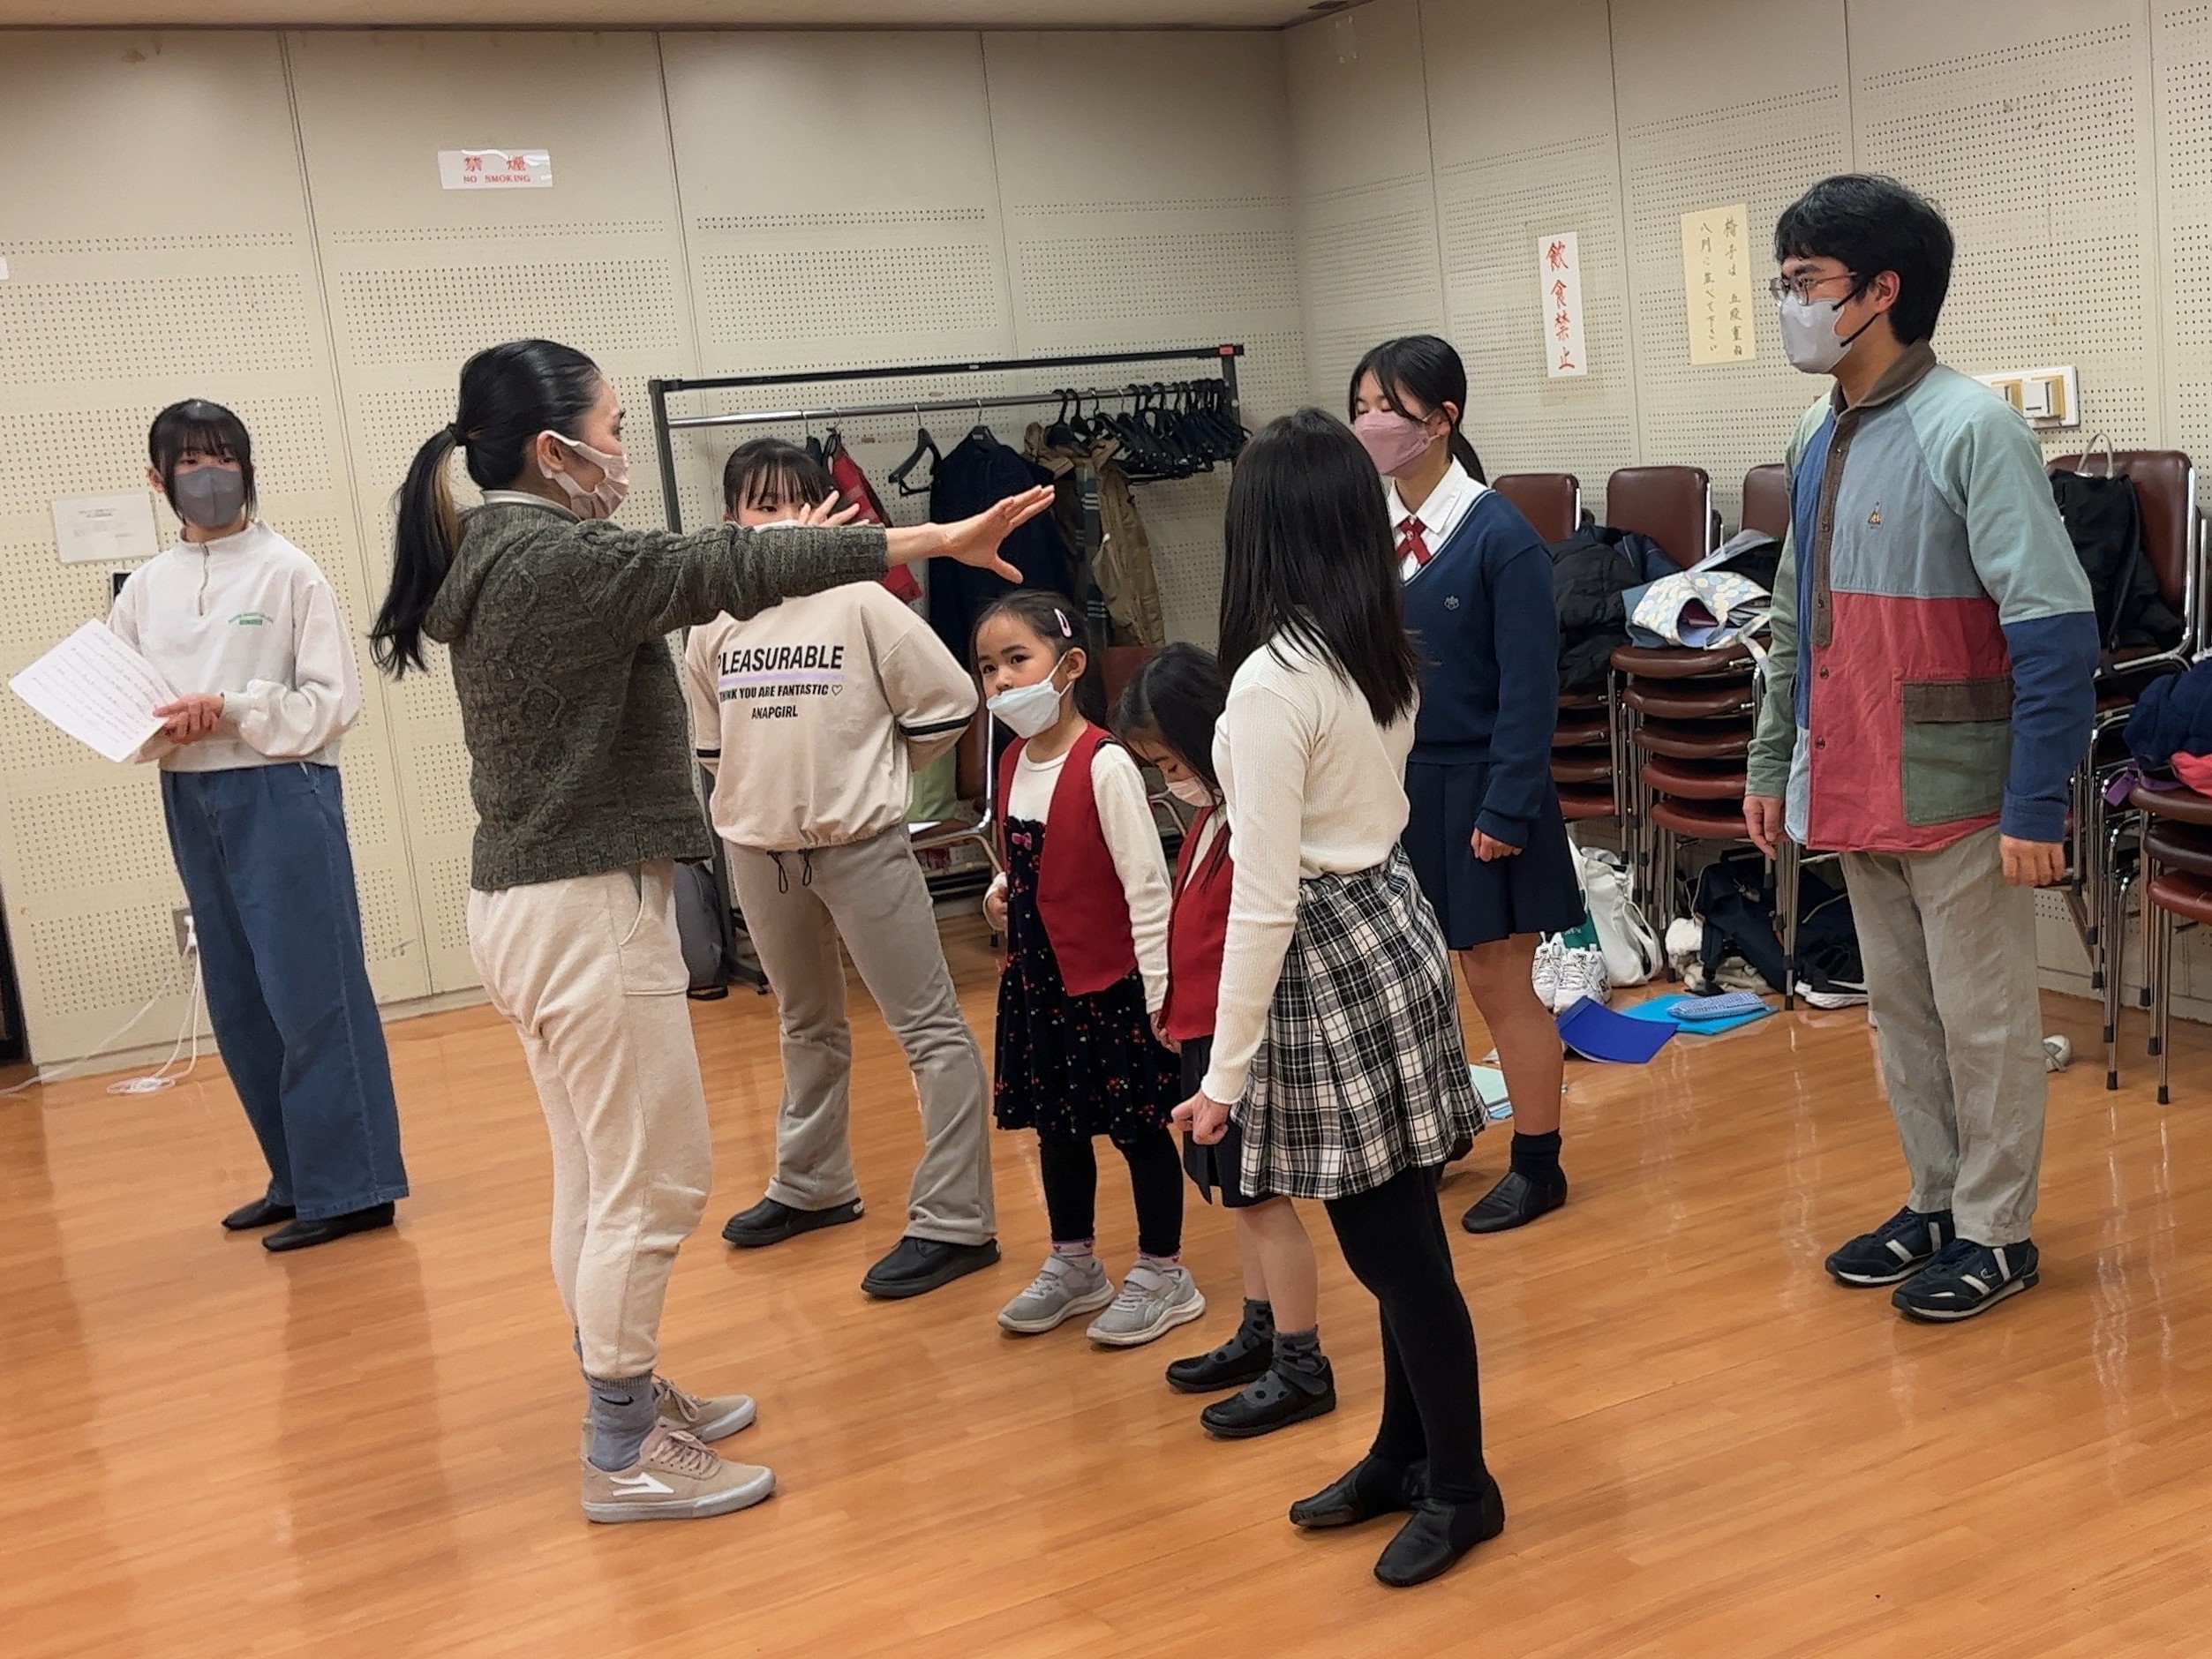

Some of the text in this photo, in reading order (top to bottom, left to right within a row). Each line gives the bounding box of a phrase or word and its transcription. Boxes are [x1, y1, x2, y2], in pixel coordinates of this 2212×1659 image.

[463, 174, 531, 184] NO SMOKING
[1546, 240, 1576, 371] 飲食禁止
[740, 687, 756, 699] YOU
[758, 686, 775, 698] ARE
[778, 684, 829, 697] FANTASTIC
[751, 705, 798, 720] ANAPGIRL
